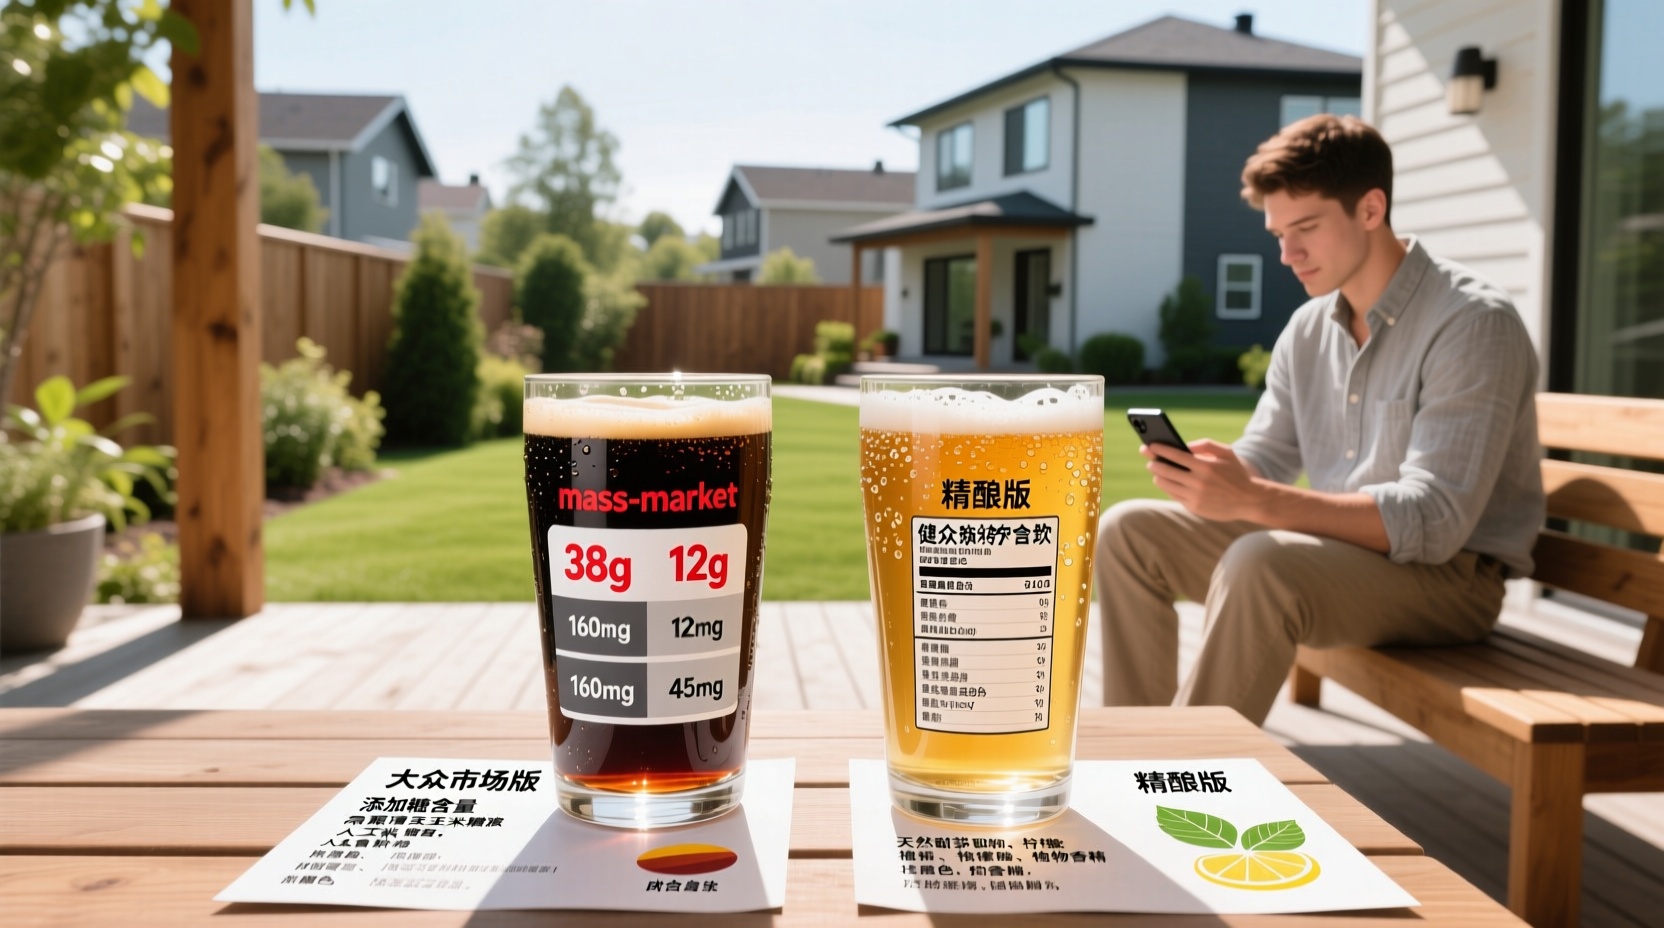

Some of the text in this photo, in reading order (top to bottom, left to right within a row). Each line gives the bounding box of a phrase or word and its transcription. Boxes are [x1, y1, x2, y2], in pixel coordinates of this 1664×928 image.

[558, 481, 738, 512] mass-market
[941, 478, 1031, 509] 精酿版
[564, 543, 728, 592] 38g 12g
[568, 614, 723, 644] 160mg 12mg
[570, 674, 723, 706] 160mg 45mg
[386, 768, 542, 792] 大众市场版
[1133, 770, 1232, 794] 精酿版
